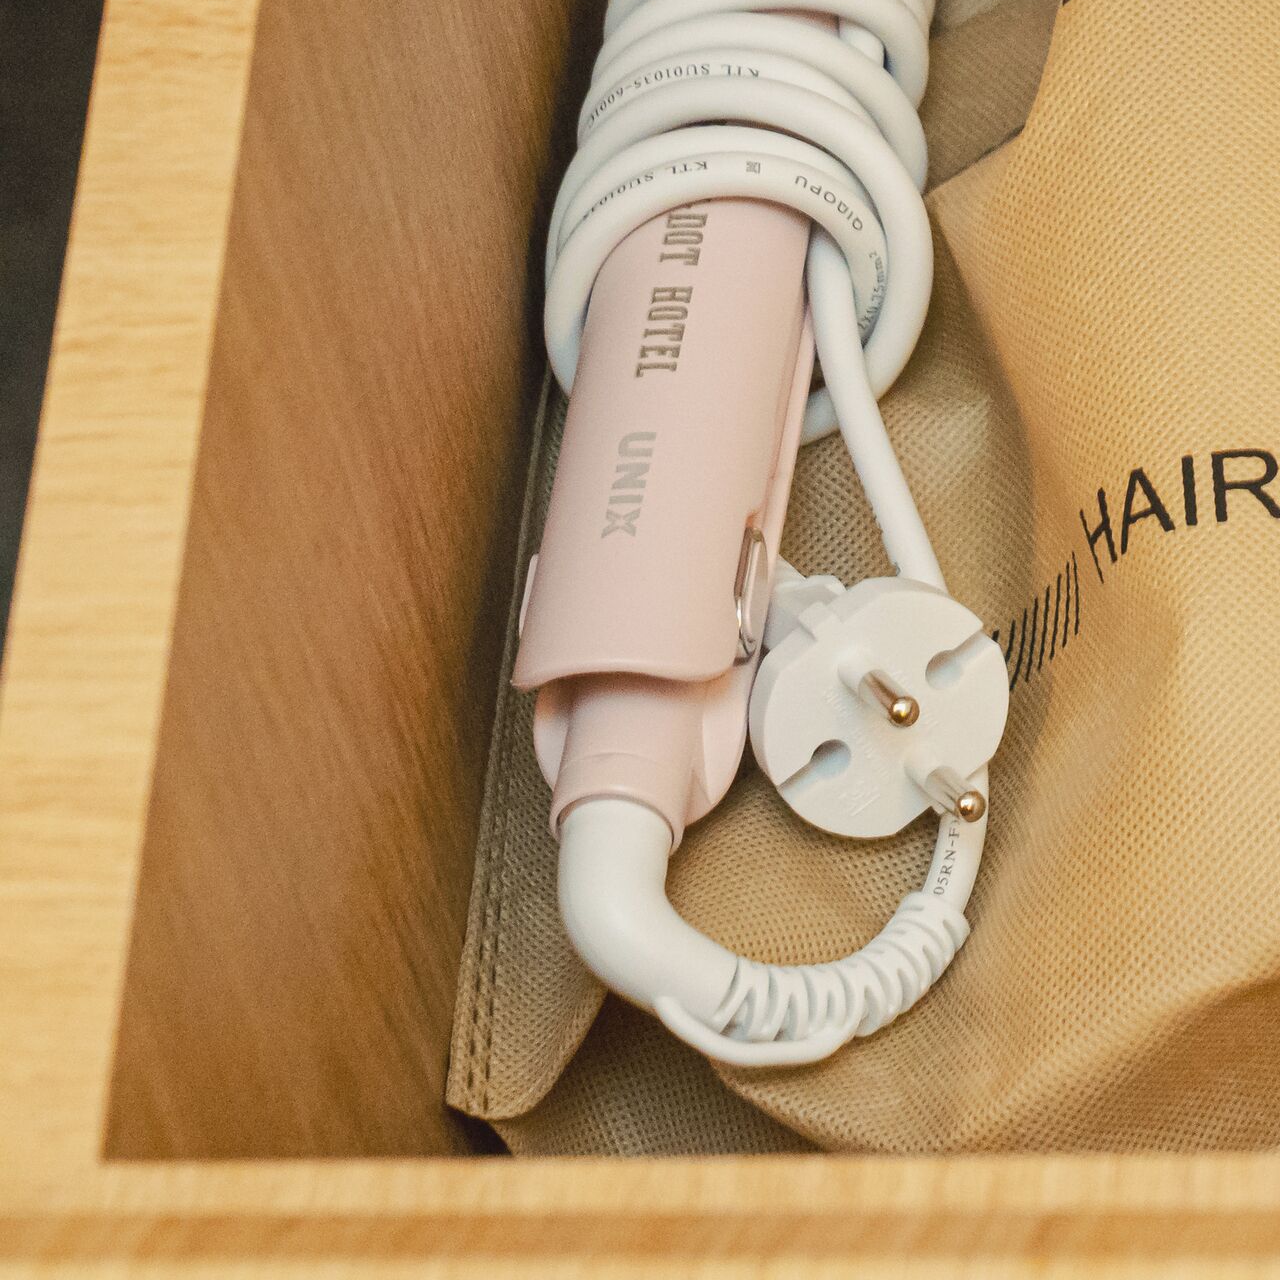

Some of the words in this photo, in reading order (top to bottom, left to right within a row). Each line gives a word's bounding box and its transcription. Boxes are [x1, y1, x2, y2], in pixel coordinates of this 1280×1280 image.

[665, 161, 709, 175] KTL
[659, 213, 708, 267] DOT
[634, 285, 694, 379] HOTEL
[600, 430, 658, 540] UNIX
